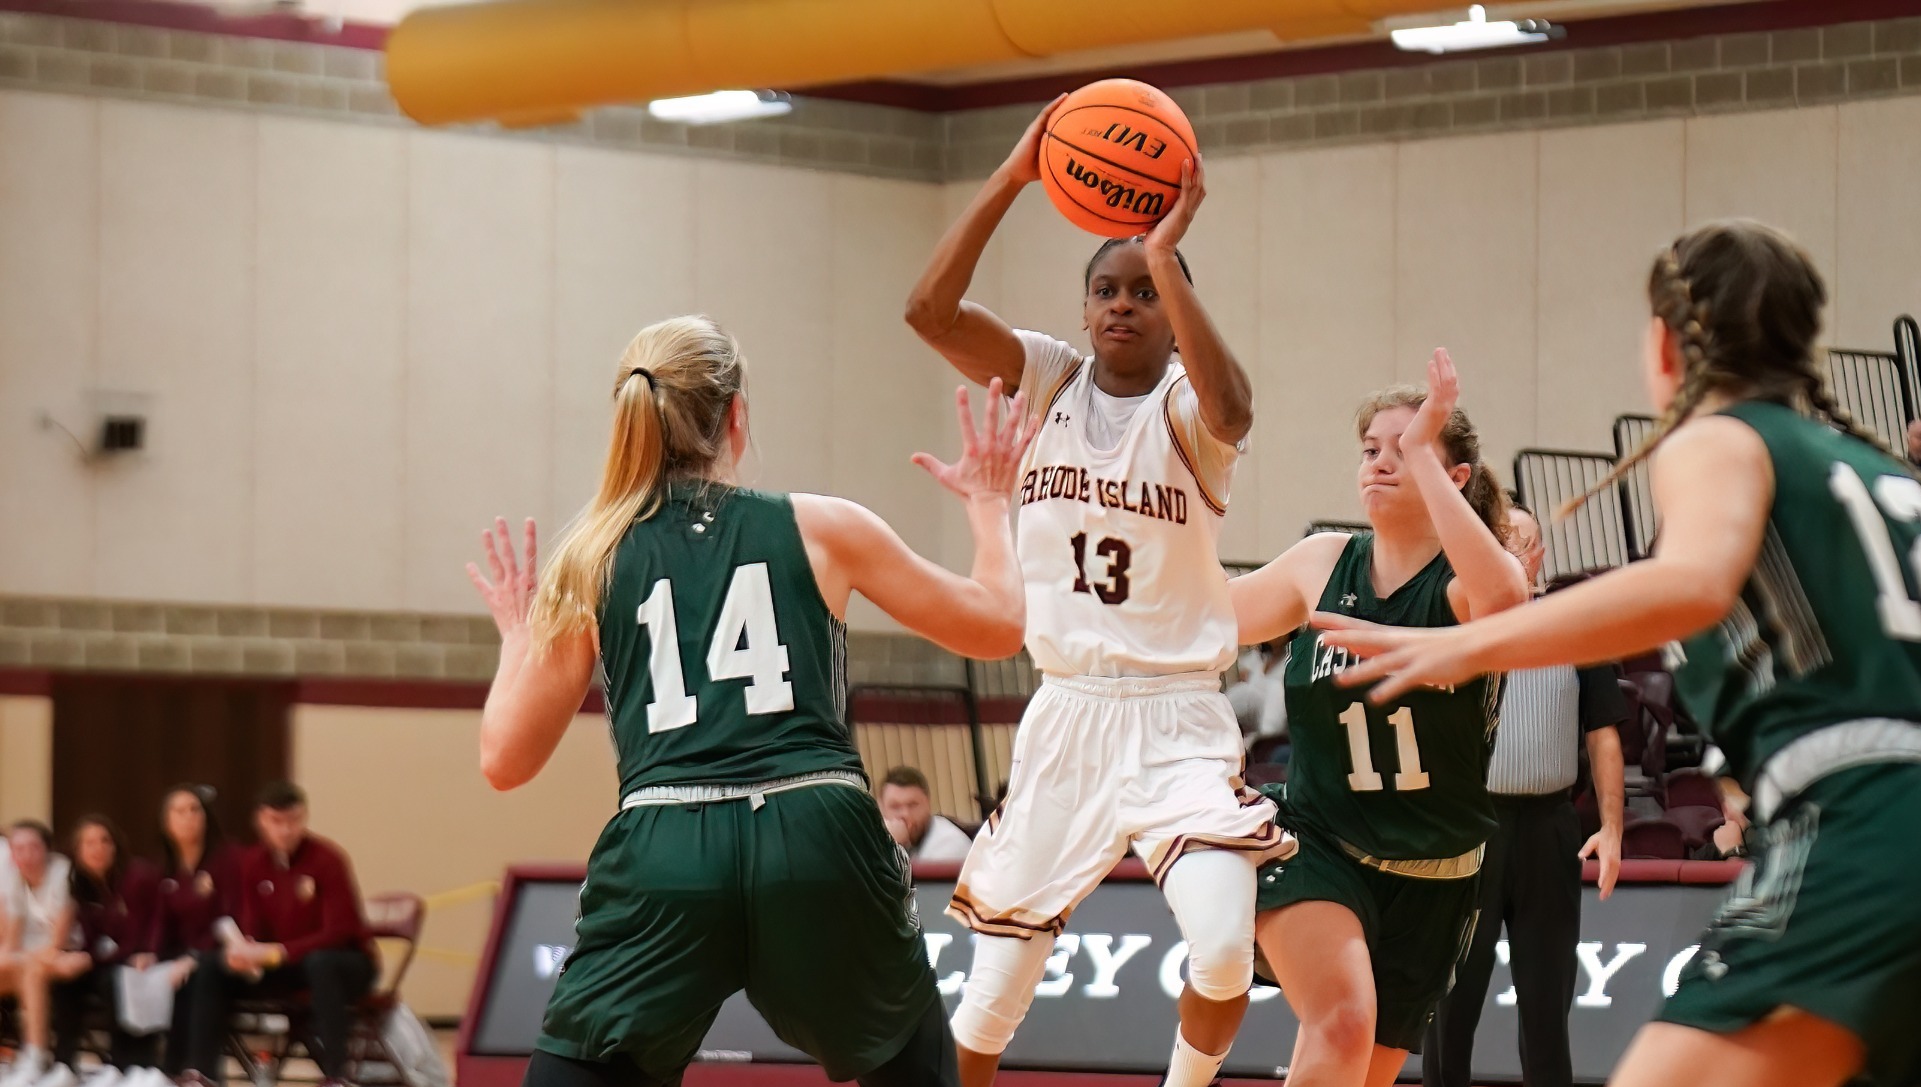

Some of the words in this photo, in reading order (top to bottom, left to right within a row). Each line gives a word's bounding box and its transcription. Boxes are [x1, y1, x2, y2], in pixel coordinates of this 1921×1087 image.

[1102, 123, 1167, 160] EVO
[1066, 157, 1164, 216] Wilson
[1096, 478, 1187, 525] ISLAND
[1070, 531, 1132, 605] 13
[637, 562, 795, 735] 14
[1338, 701, 1431, 791] 11
